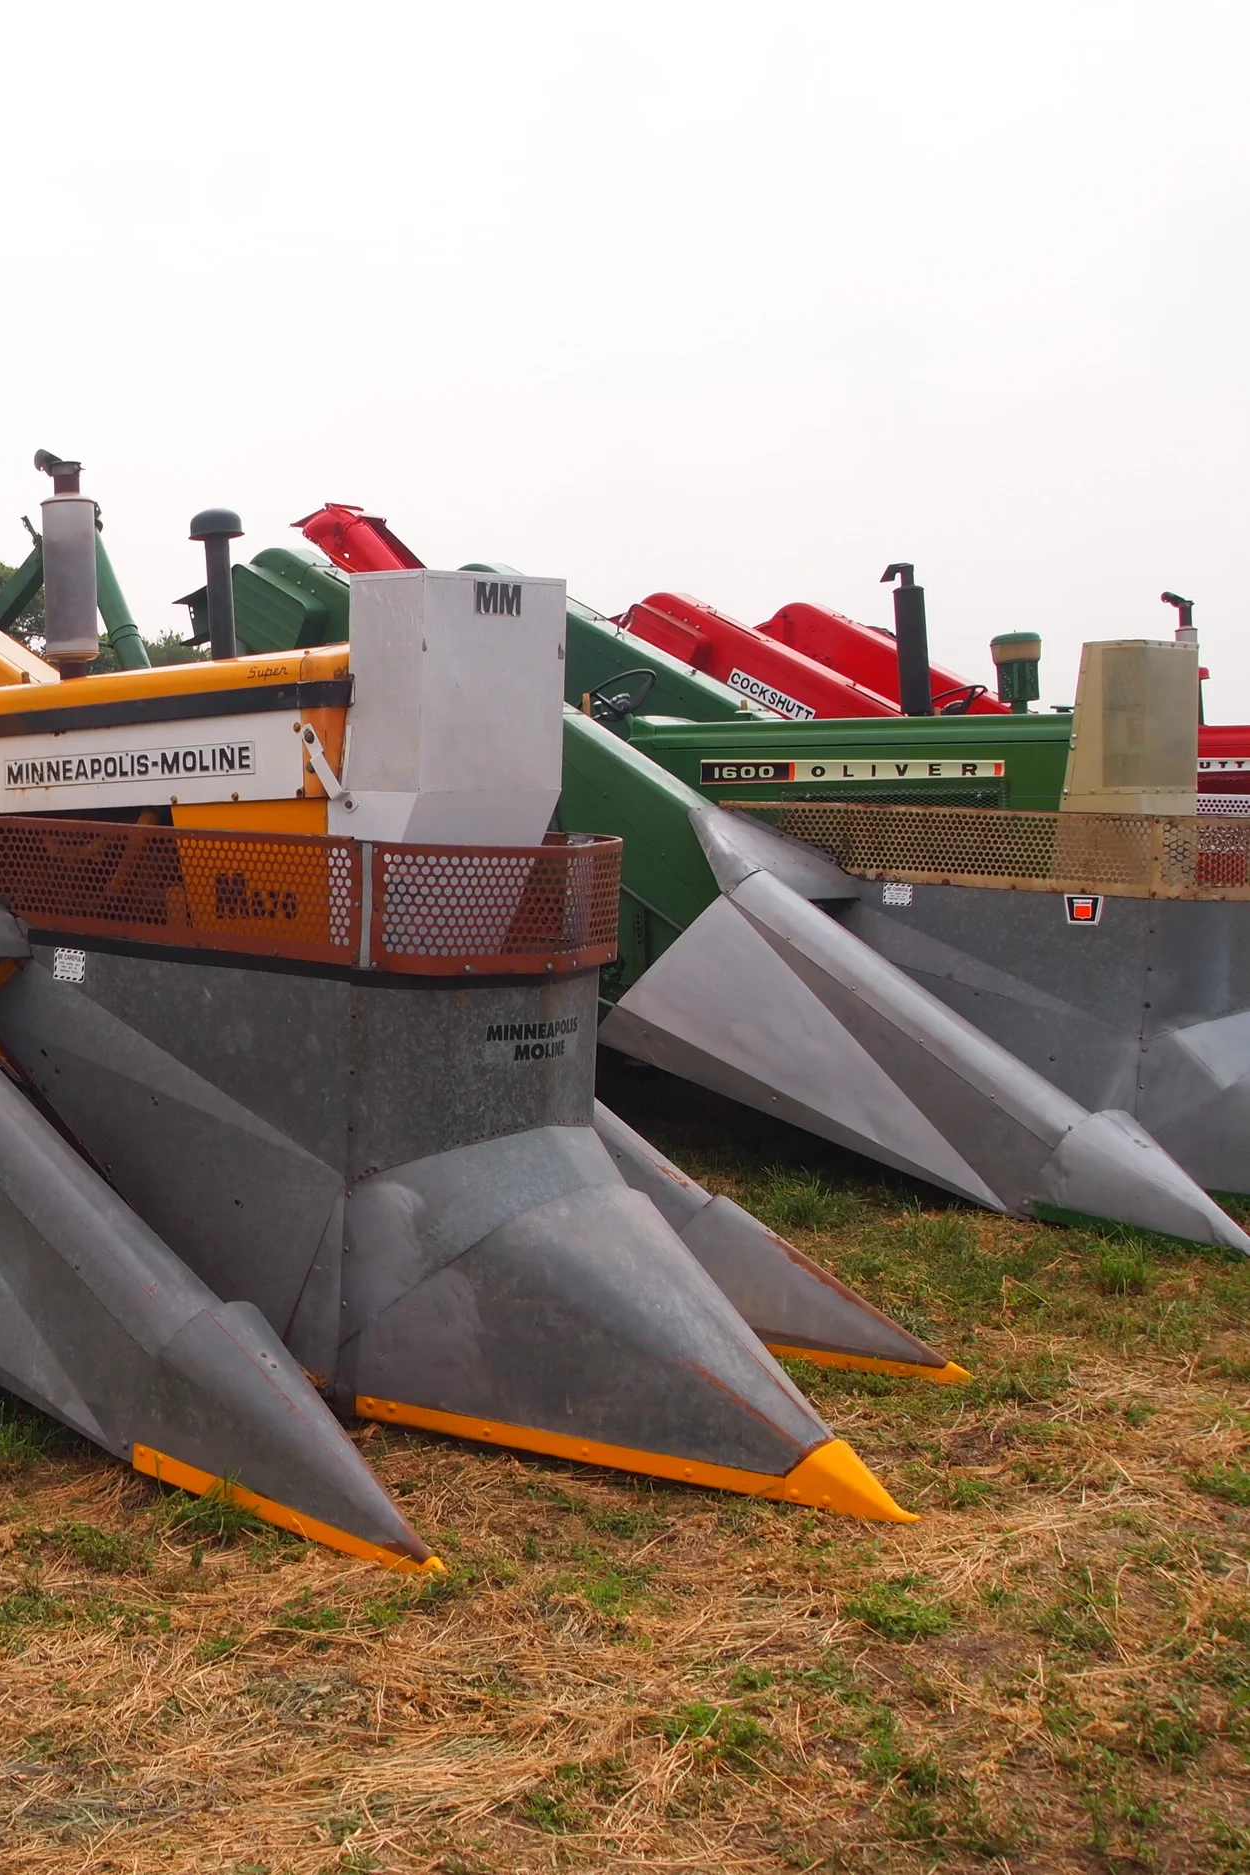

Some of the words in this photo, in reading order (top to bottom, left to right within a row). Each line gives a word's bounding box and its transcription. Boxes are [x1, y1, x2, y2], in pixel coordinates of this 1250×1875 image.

[475, 581, 522, 616] MM
[247, 666, 288, 681] Super
[731, 672, 813, 719] COCKSHUTT
[6, 746, 251, 785] MINNEAPOLIS-MOLINE
[713, 765, 775, 779] 1600
[811, 763, 978, 778] OLIVER
[486, 1017, 578, 1042] MINNEAPOLIS
[513, 1040, 566, 1061] MOLINE
